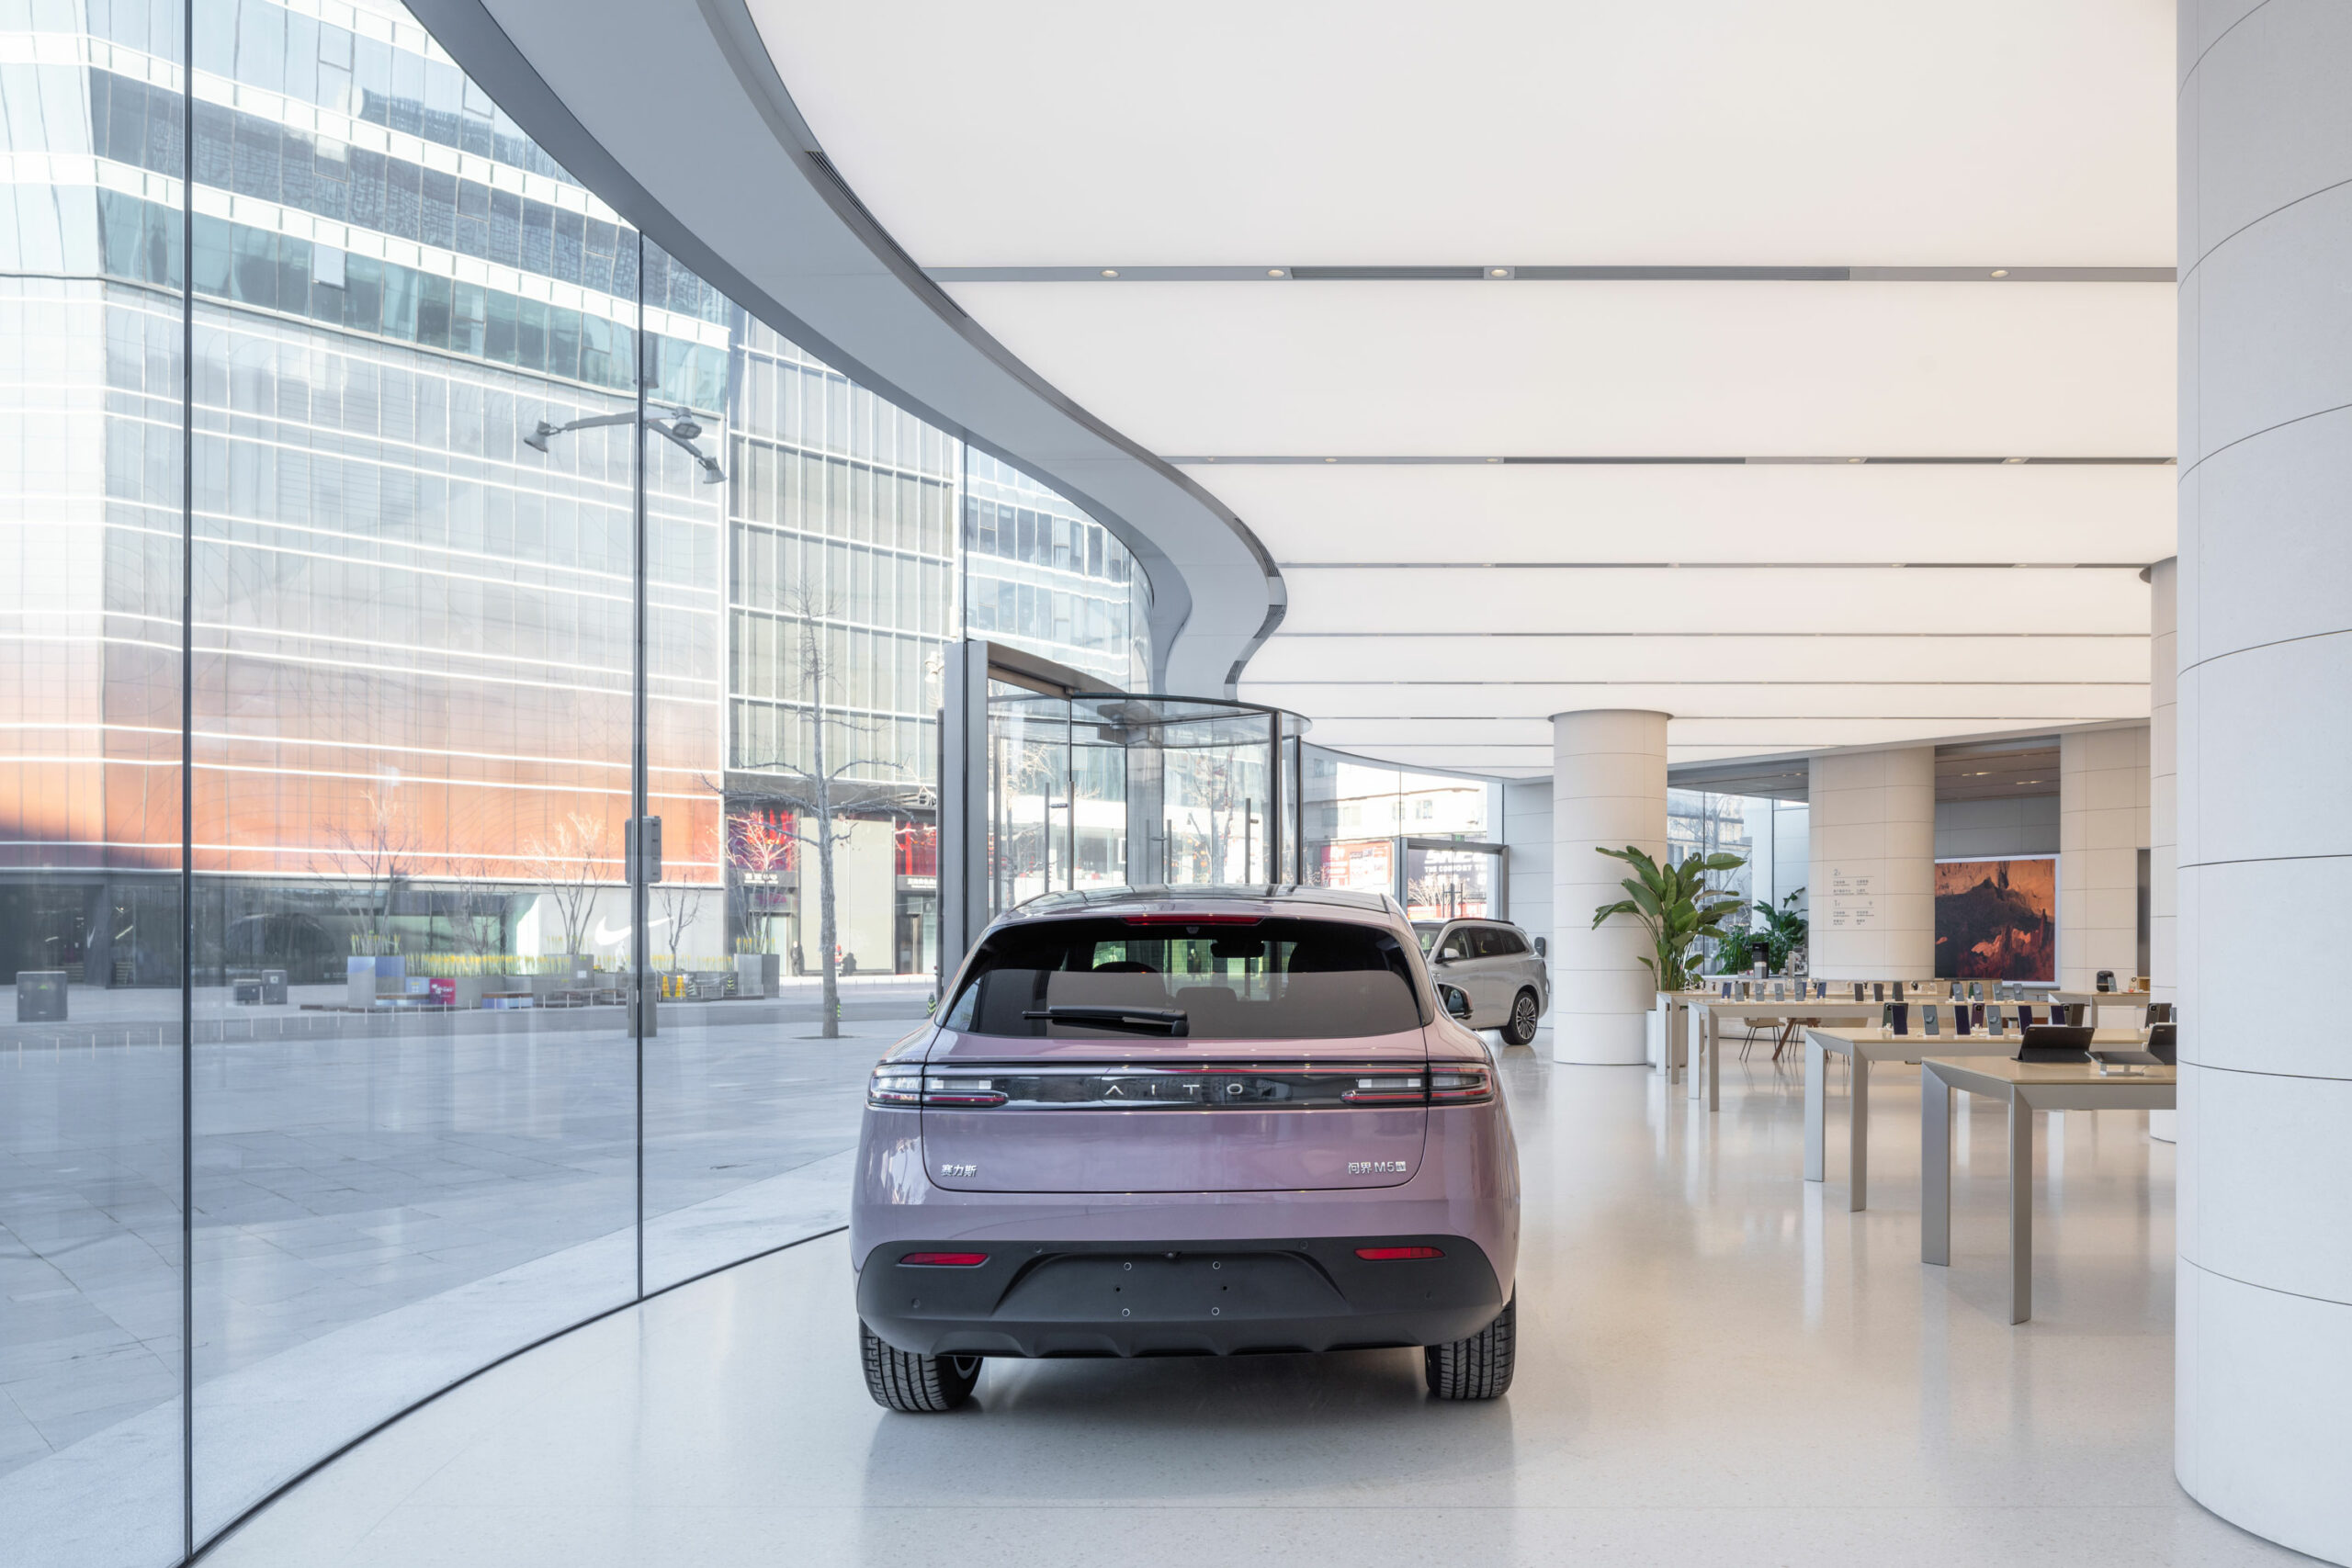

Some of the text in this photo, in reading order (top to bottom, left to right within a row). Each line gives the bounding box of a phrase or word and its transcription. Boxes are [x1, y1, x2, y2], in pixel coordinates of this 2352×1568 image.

[1104, 1083, 1244, 1096] AITO
[941, 1164, 978, 1177] 赛力斯
